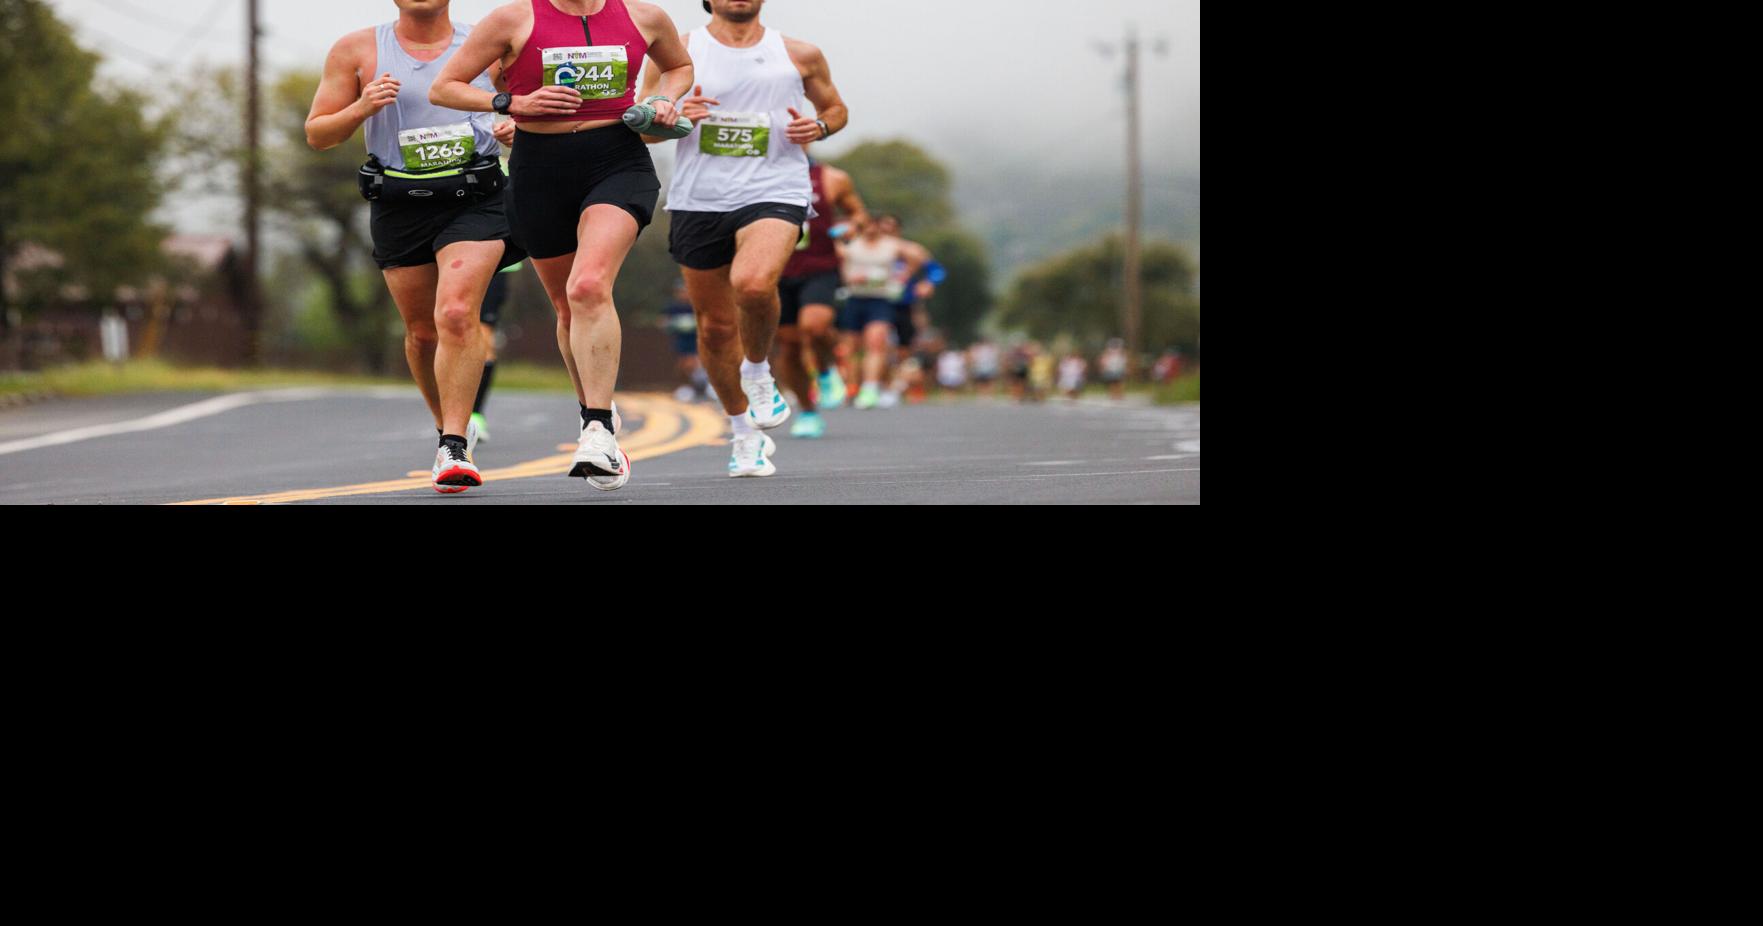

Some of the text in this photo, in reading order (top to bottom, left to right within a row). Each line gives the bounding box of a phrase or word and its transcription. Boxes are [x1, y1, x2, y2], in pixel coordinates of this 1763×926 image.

[575, 65, 614, 82] 944
[717, 128, 752, 142] 575
[415, 141, 465, 161] 1266
